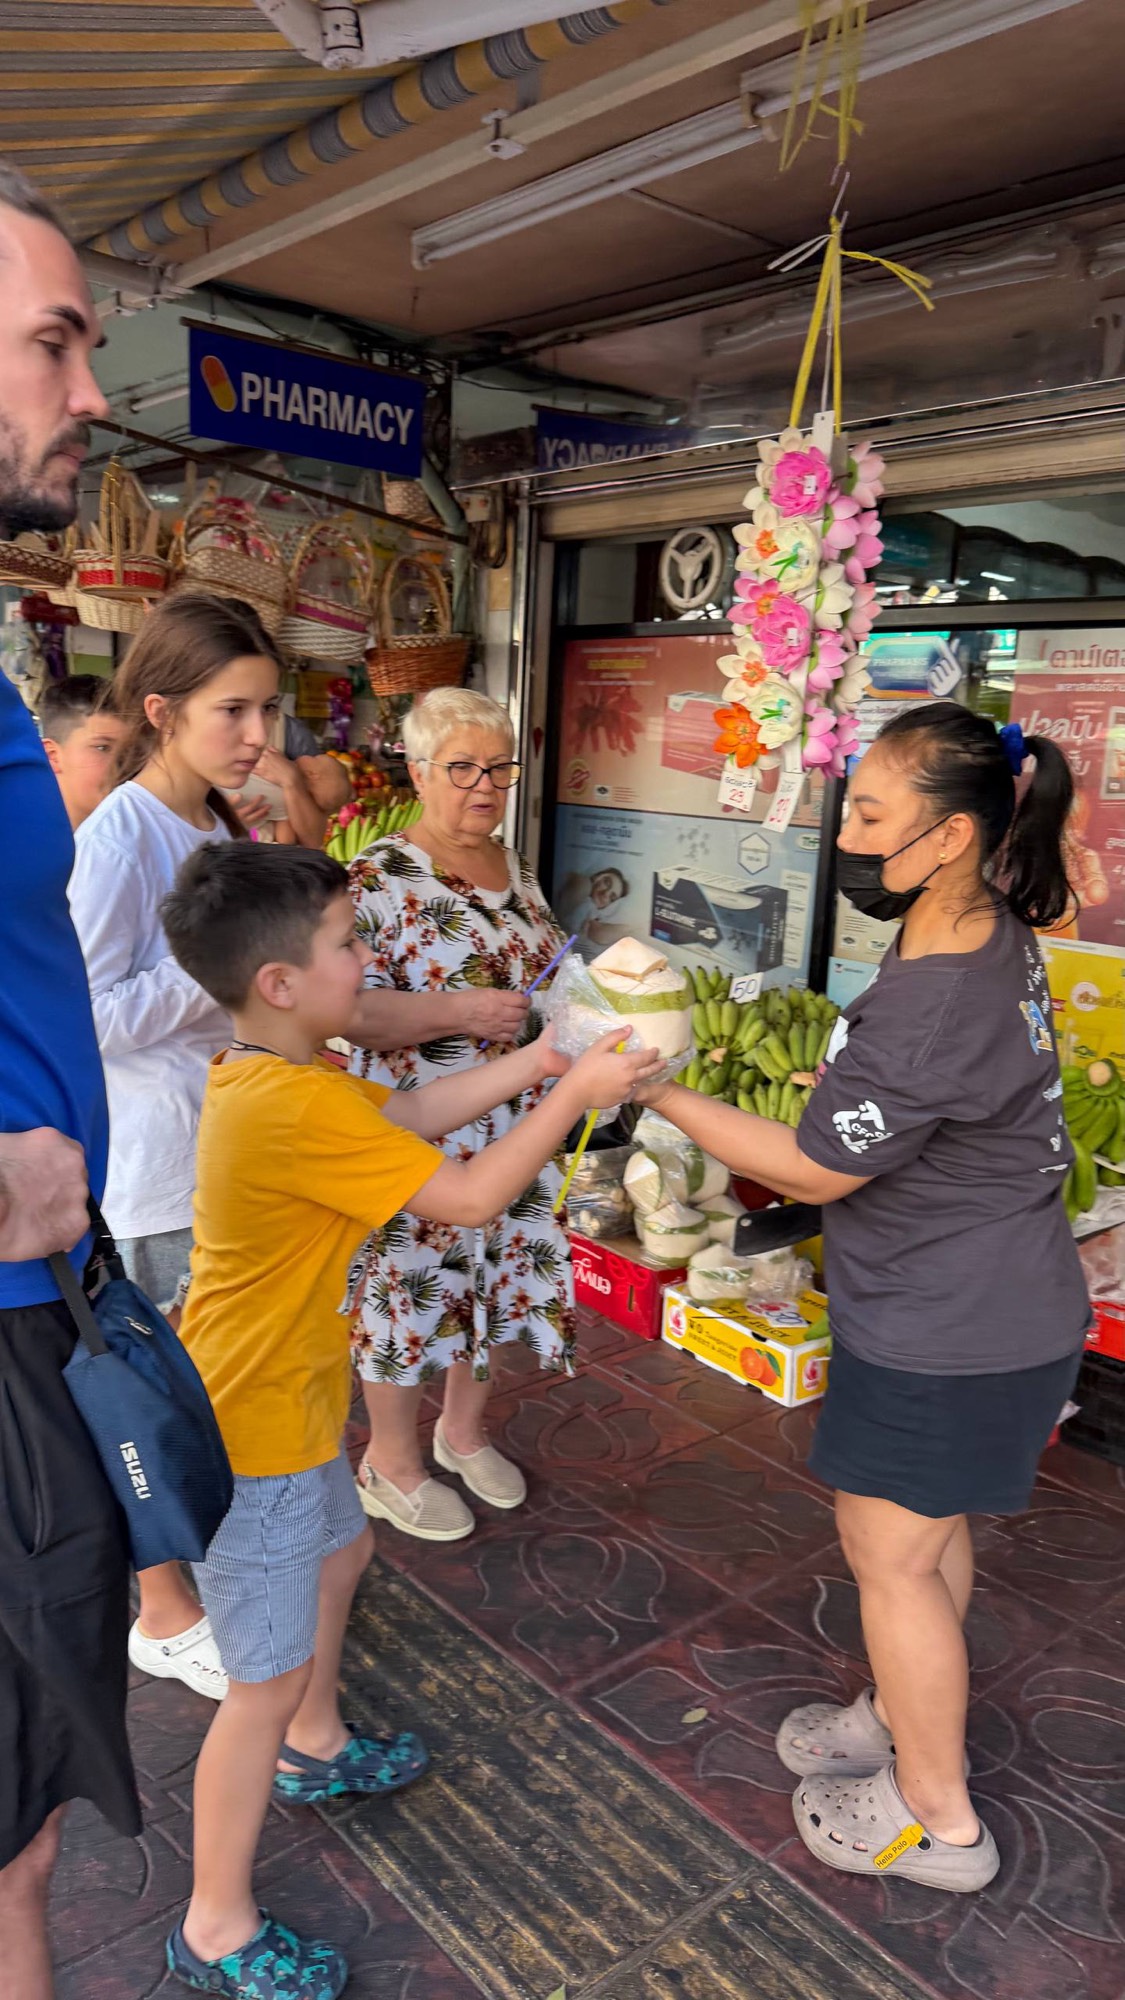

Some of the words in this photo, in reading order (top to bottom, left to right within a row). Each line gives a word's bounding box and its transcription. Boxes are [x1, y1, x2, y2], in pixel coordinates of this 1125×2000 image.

[241, 372, 414, 445] PHARMACY
[734, 979, 758, 1000] 50
[120, 1441, 152, 1500] ISUZU
[876, 1853, 894, 1868] Hello
